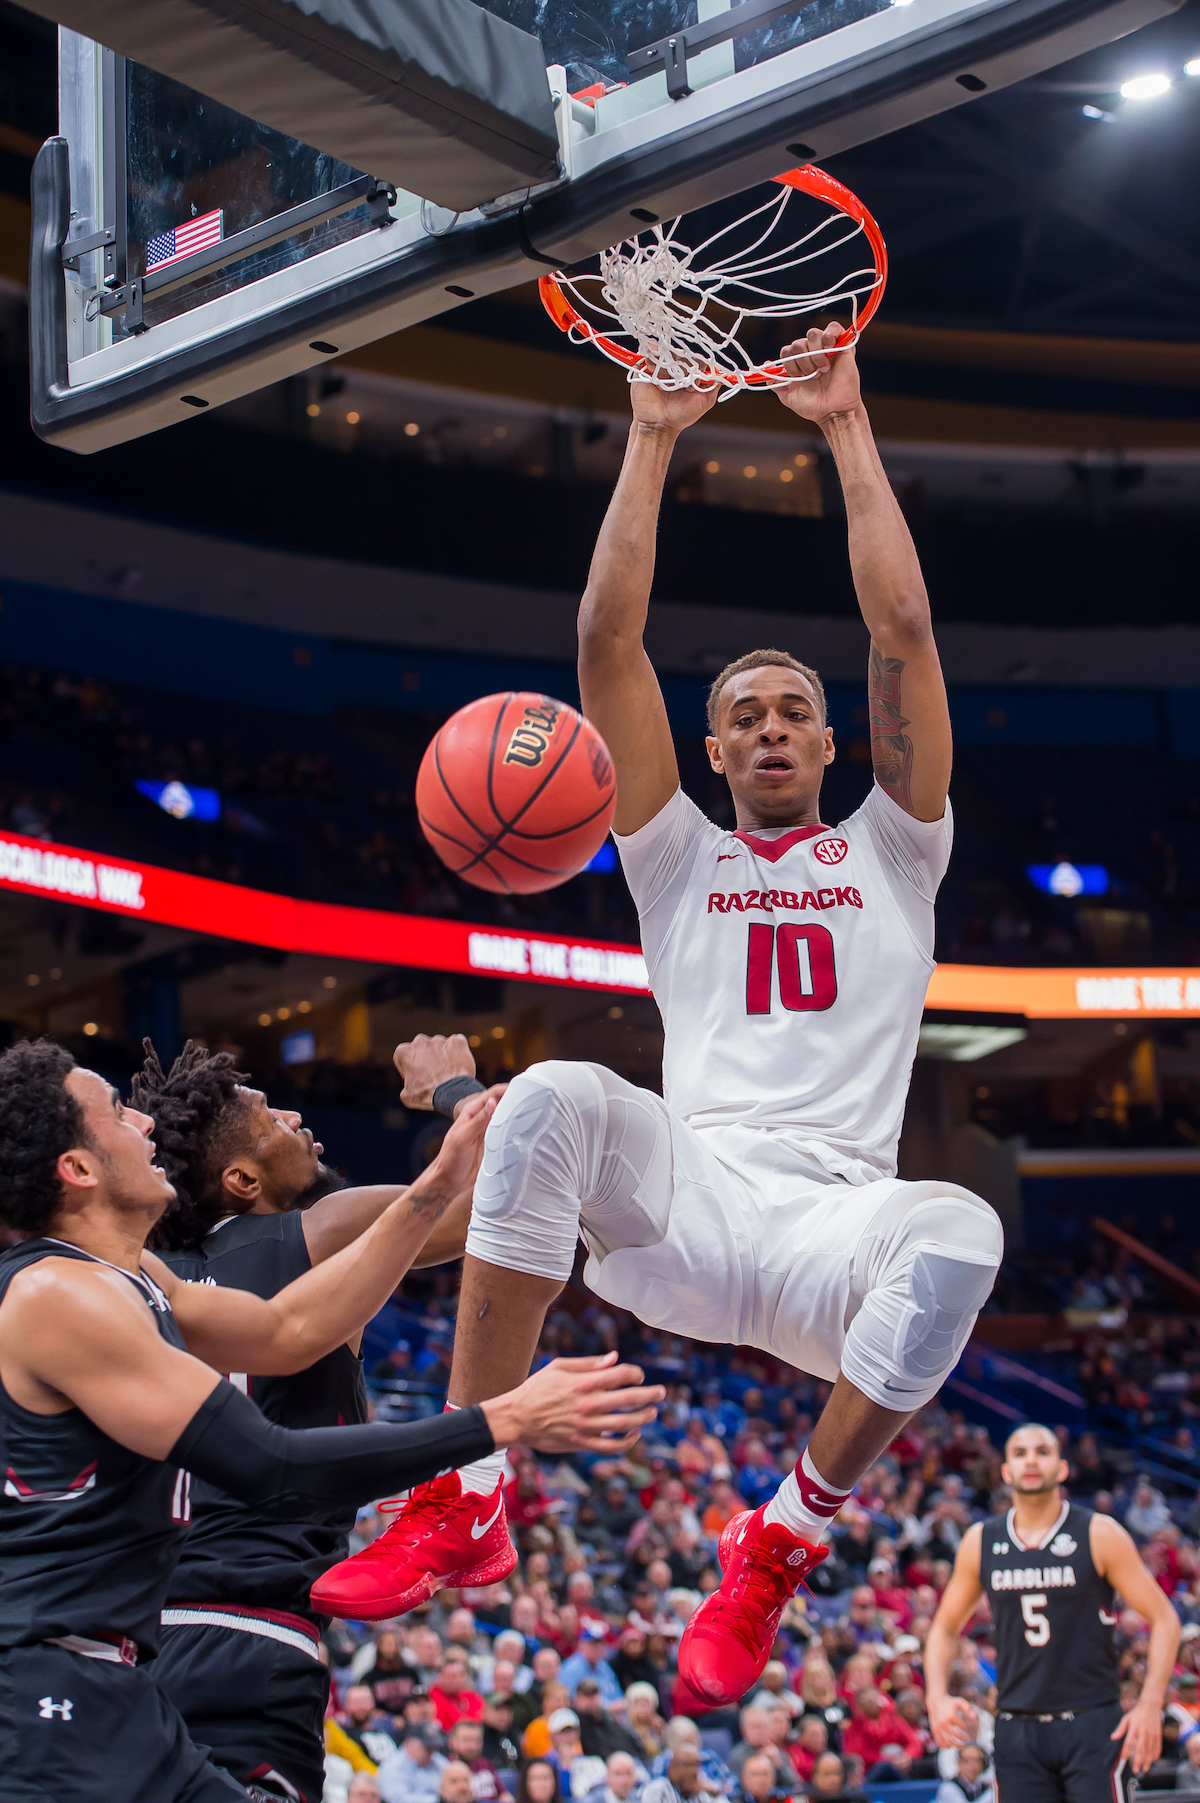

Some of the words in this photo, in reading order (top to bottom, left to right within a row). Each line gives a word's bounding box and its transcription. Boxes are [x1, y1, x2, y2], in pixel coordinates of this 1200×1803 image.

[814, 838, 848, 865] SEC
[707, 886, 863, 914] RAZORBACKS
[468, 932, 530, 974] MADE
[529, 940, 570, 979] THE
[746, 922, 838, 1015] 10
[991, 1565, 1077, 1591] CAROLINA
[1020, 1593, 1050, 1647] 5
